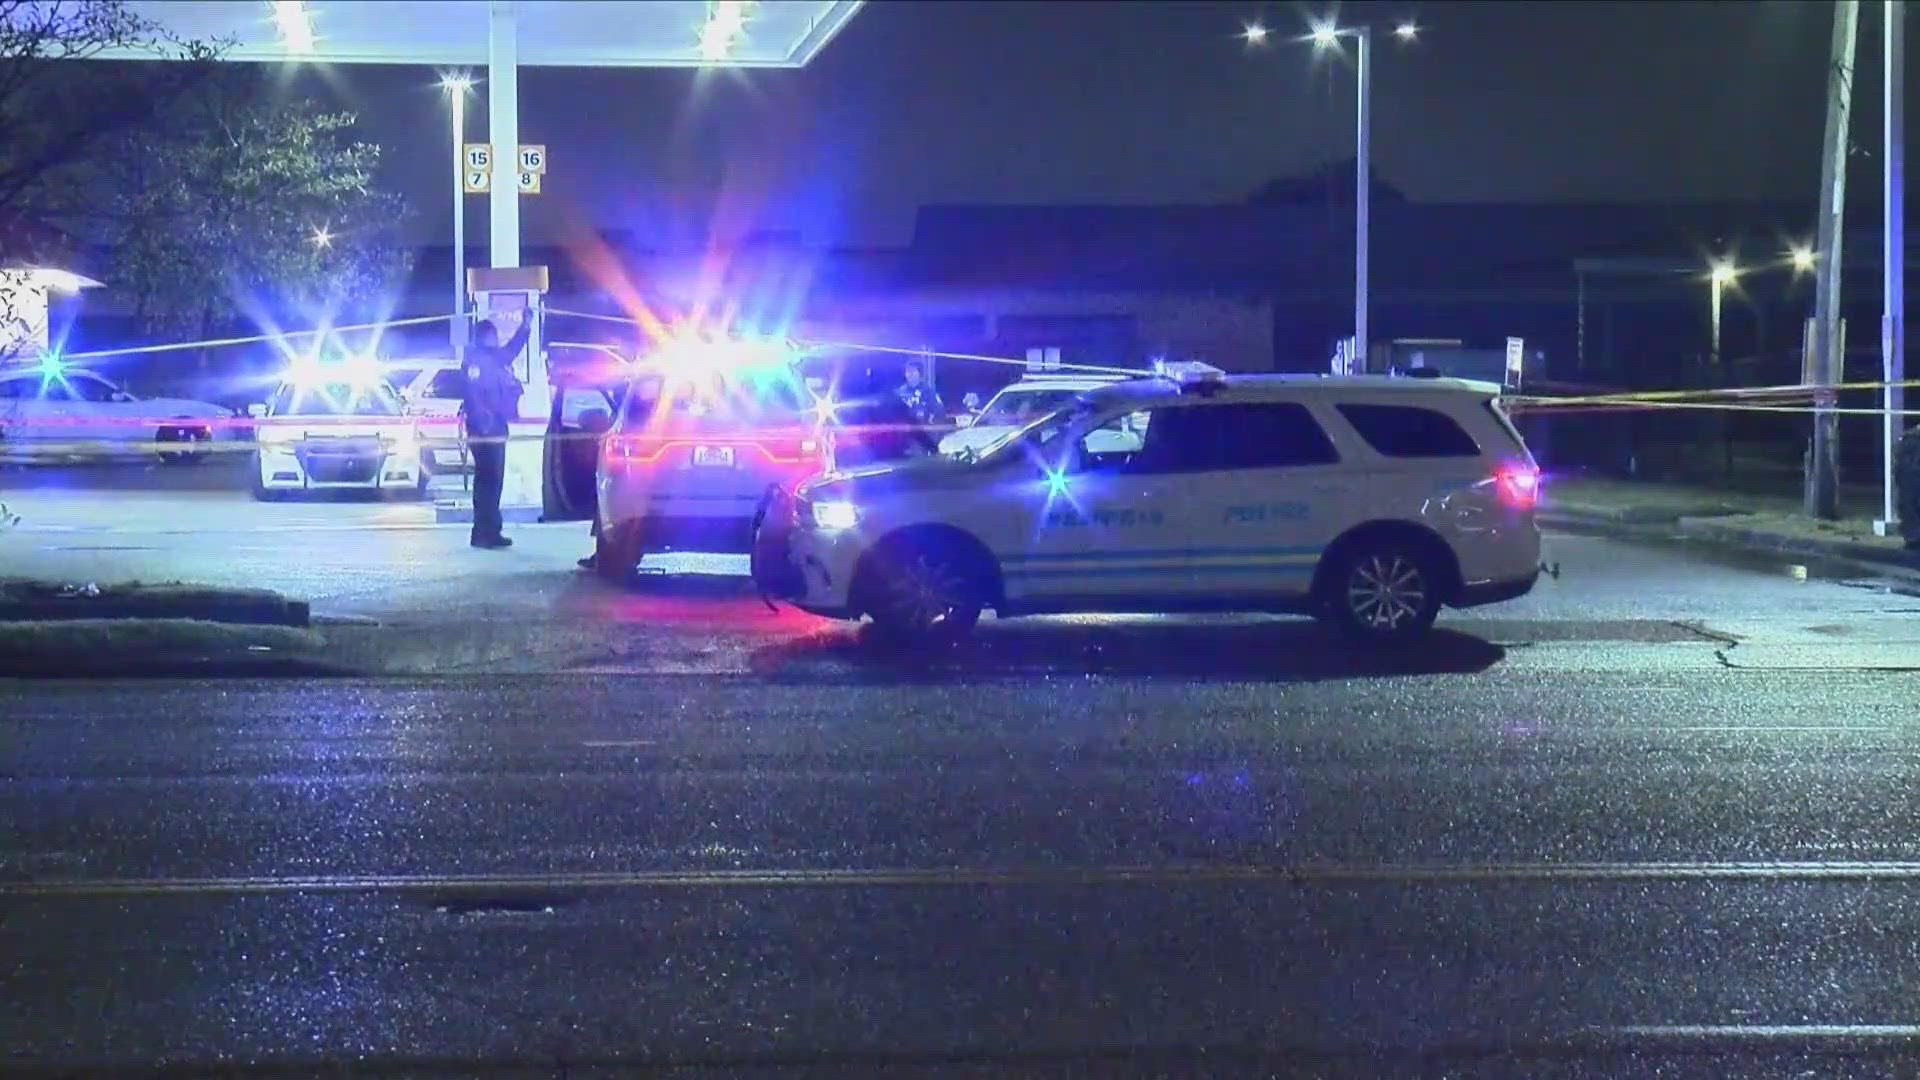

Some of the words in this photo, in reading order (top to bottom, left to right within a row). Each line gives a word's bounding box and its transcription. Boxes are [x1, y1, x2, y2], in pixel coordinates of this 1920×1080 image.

[470, 152, 488, 165] 15
[522, 152, 540, 166] 16
[473, 173, 482, 185] 7
[521, 172, 531, 185] 8
